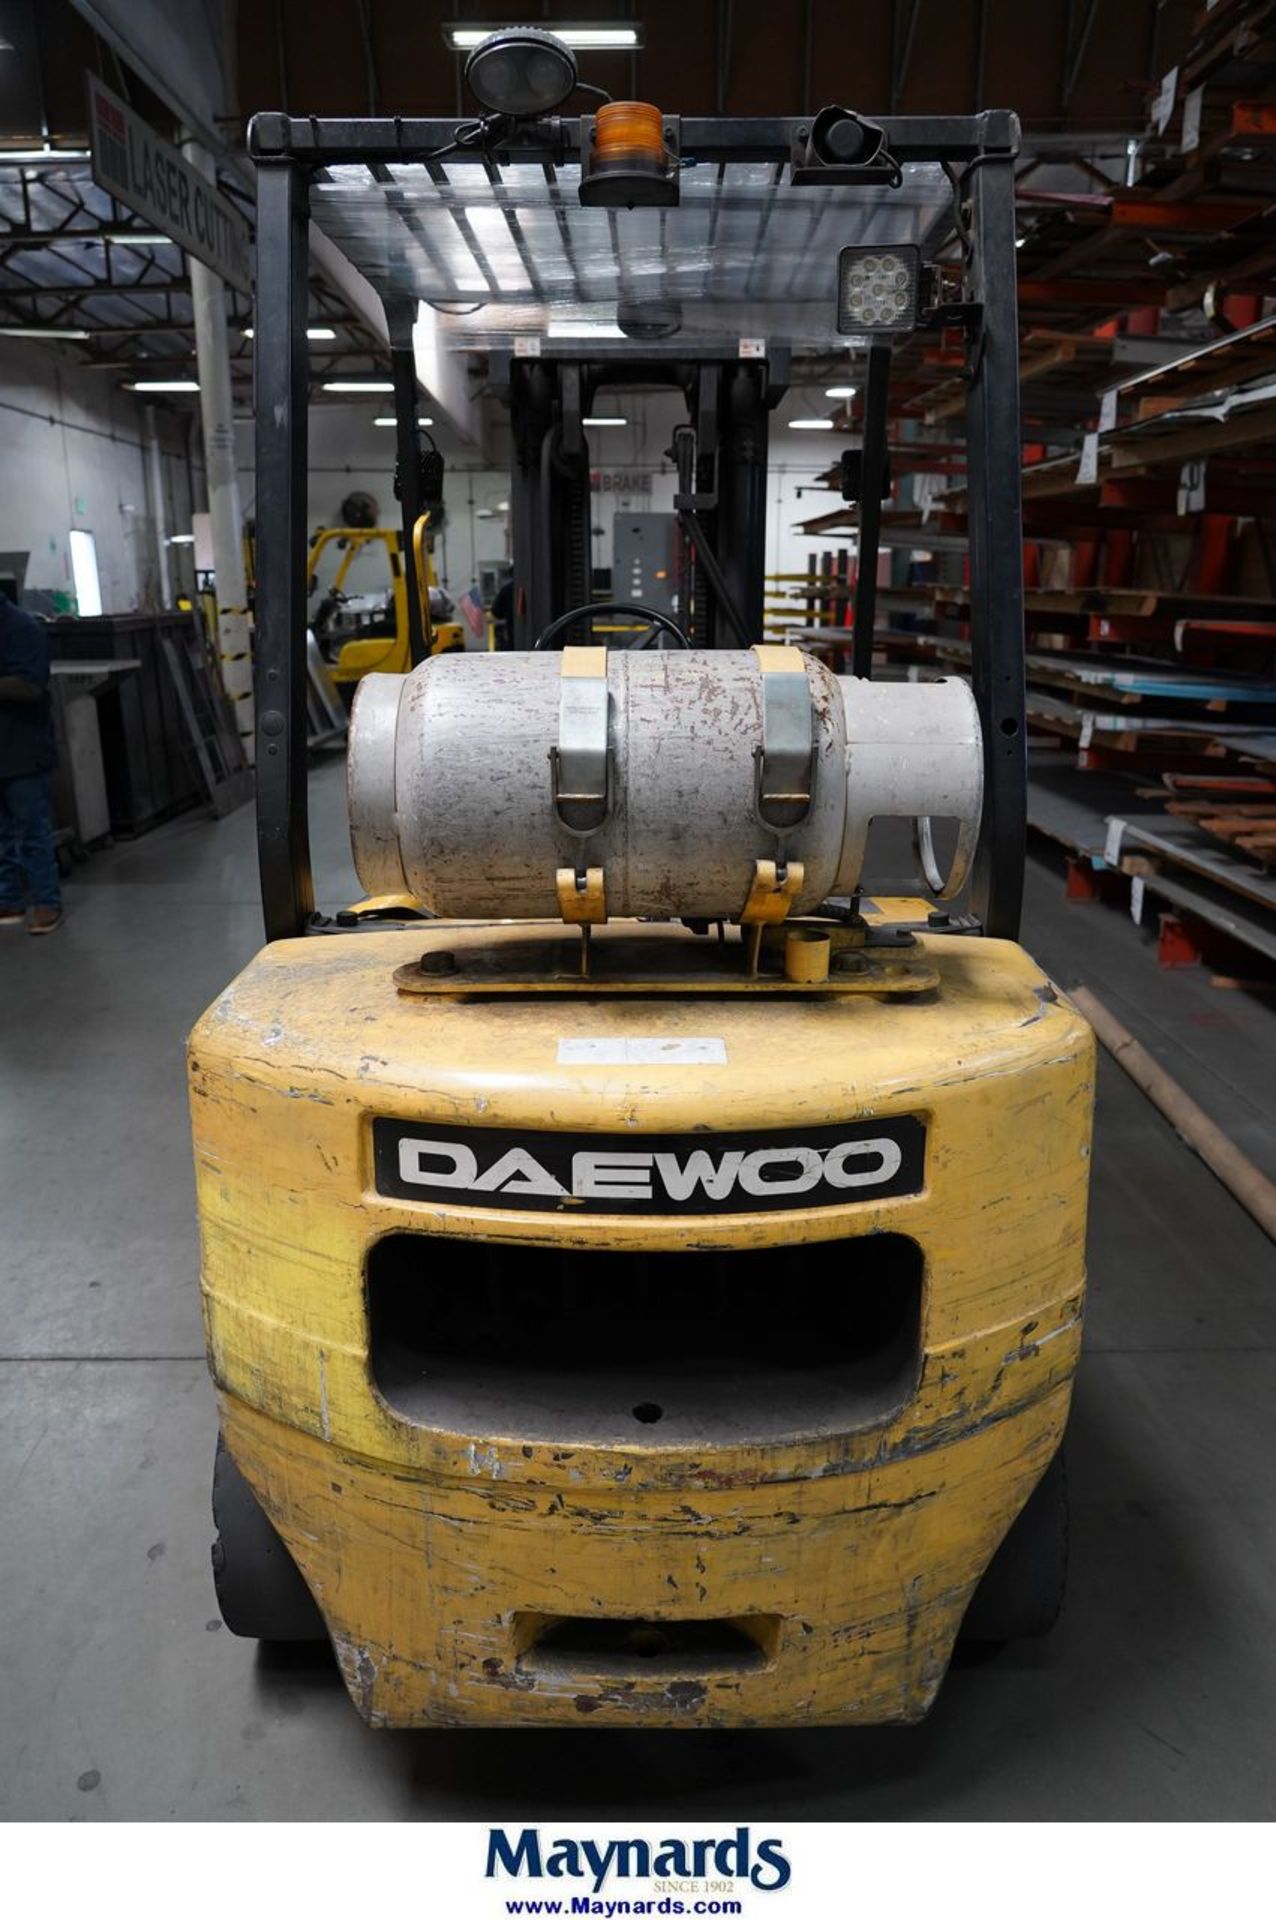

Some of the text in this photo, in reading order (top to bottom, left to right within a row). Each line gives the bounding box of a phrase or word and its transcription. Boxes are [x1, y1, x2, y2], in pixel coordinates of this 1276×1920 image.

[128, 125, 193, 236] LASER
[603, 474, 652, 493] BRAKE
[399, 1137, 901, 1200] DAEWOO
